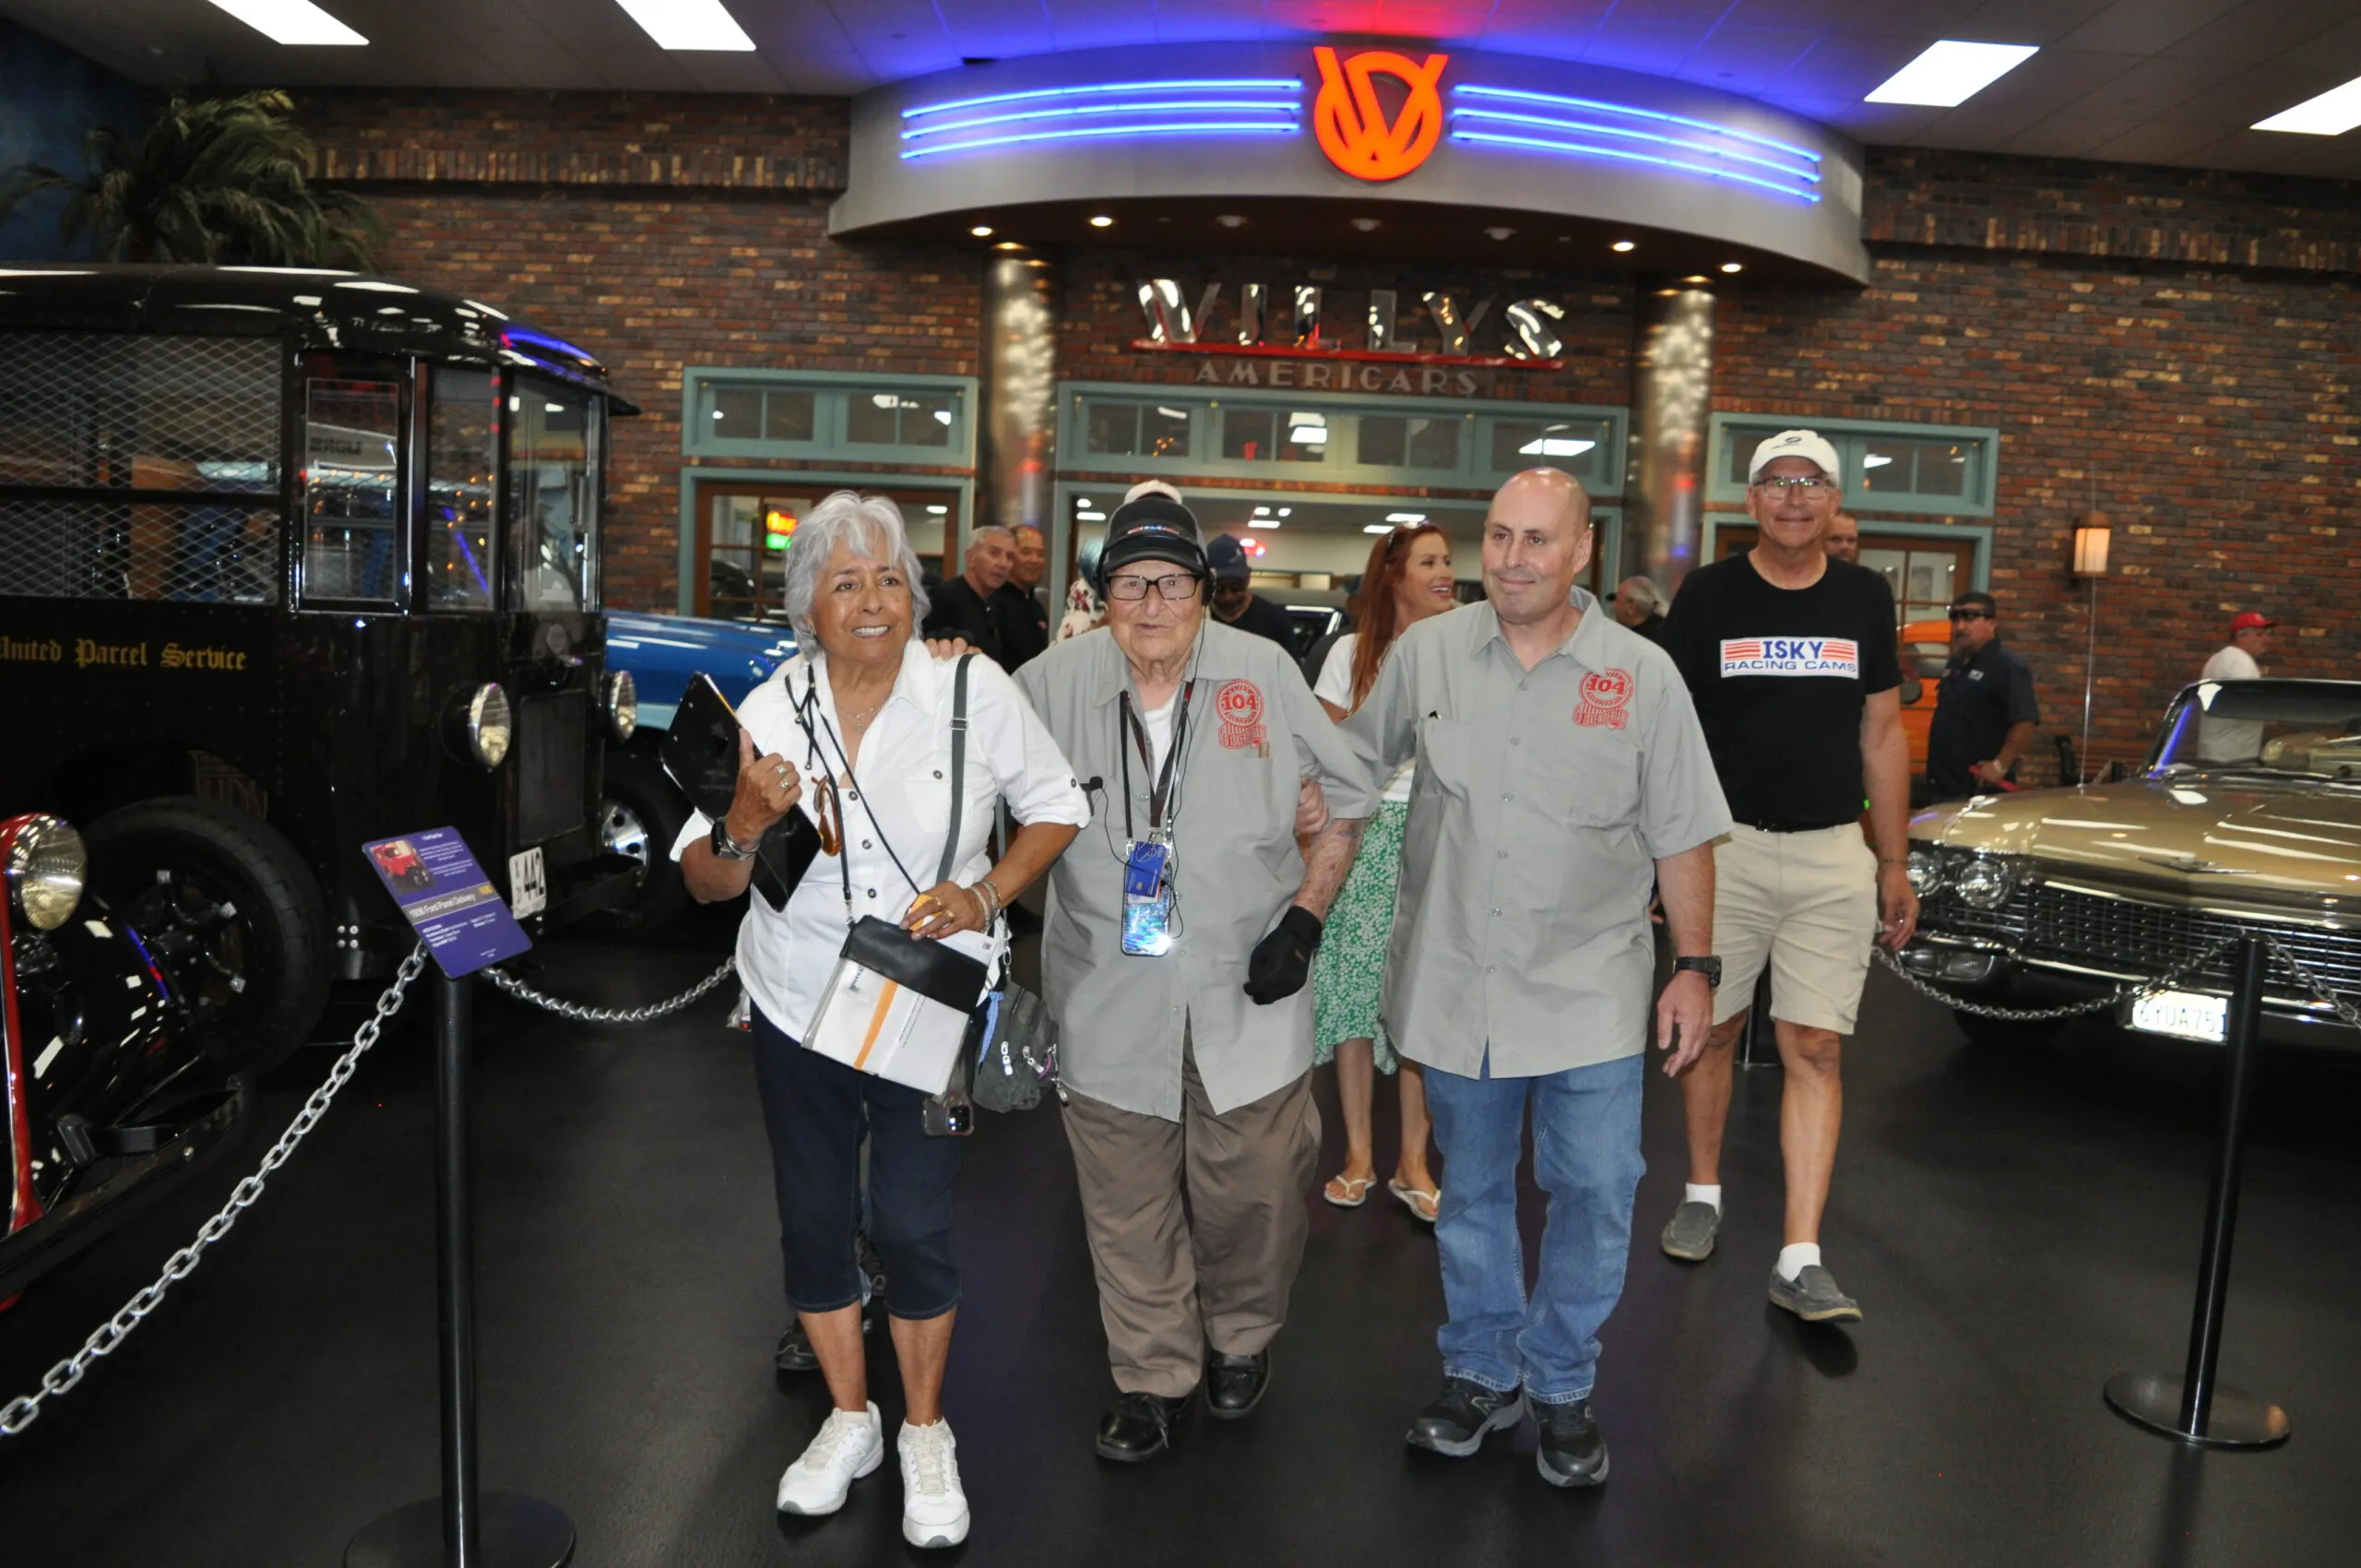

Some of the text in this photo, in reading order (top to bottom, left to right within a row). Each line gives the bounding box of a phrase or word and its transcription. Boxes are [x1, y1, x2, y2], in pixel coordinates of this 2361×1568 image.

[1137, 278, 1565, 361] WILLYS
[1195, 360, 1477, 395] AMERICARS
[74, 638, 148, 669] Parcel
[160, 642, 246, 671] Service
[1762, 640, 1823, 659] ISKY
[1724, 660, 1857, 672] RACING CAMS
[1586, 677, 1625, 695] 104
[1223, 694, 1257, 711] 104
